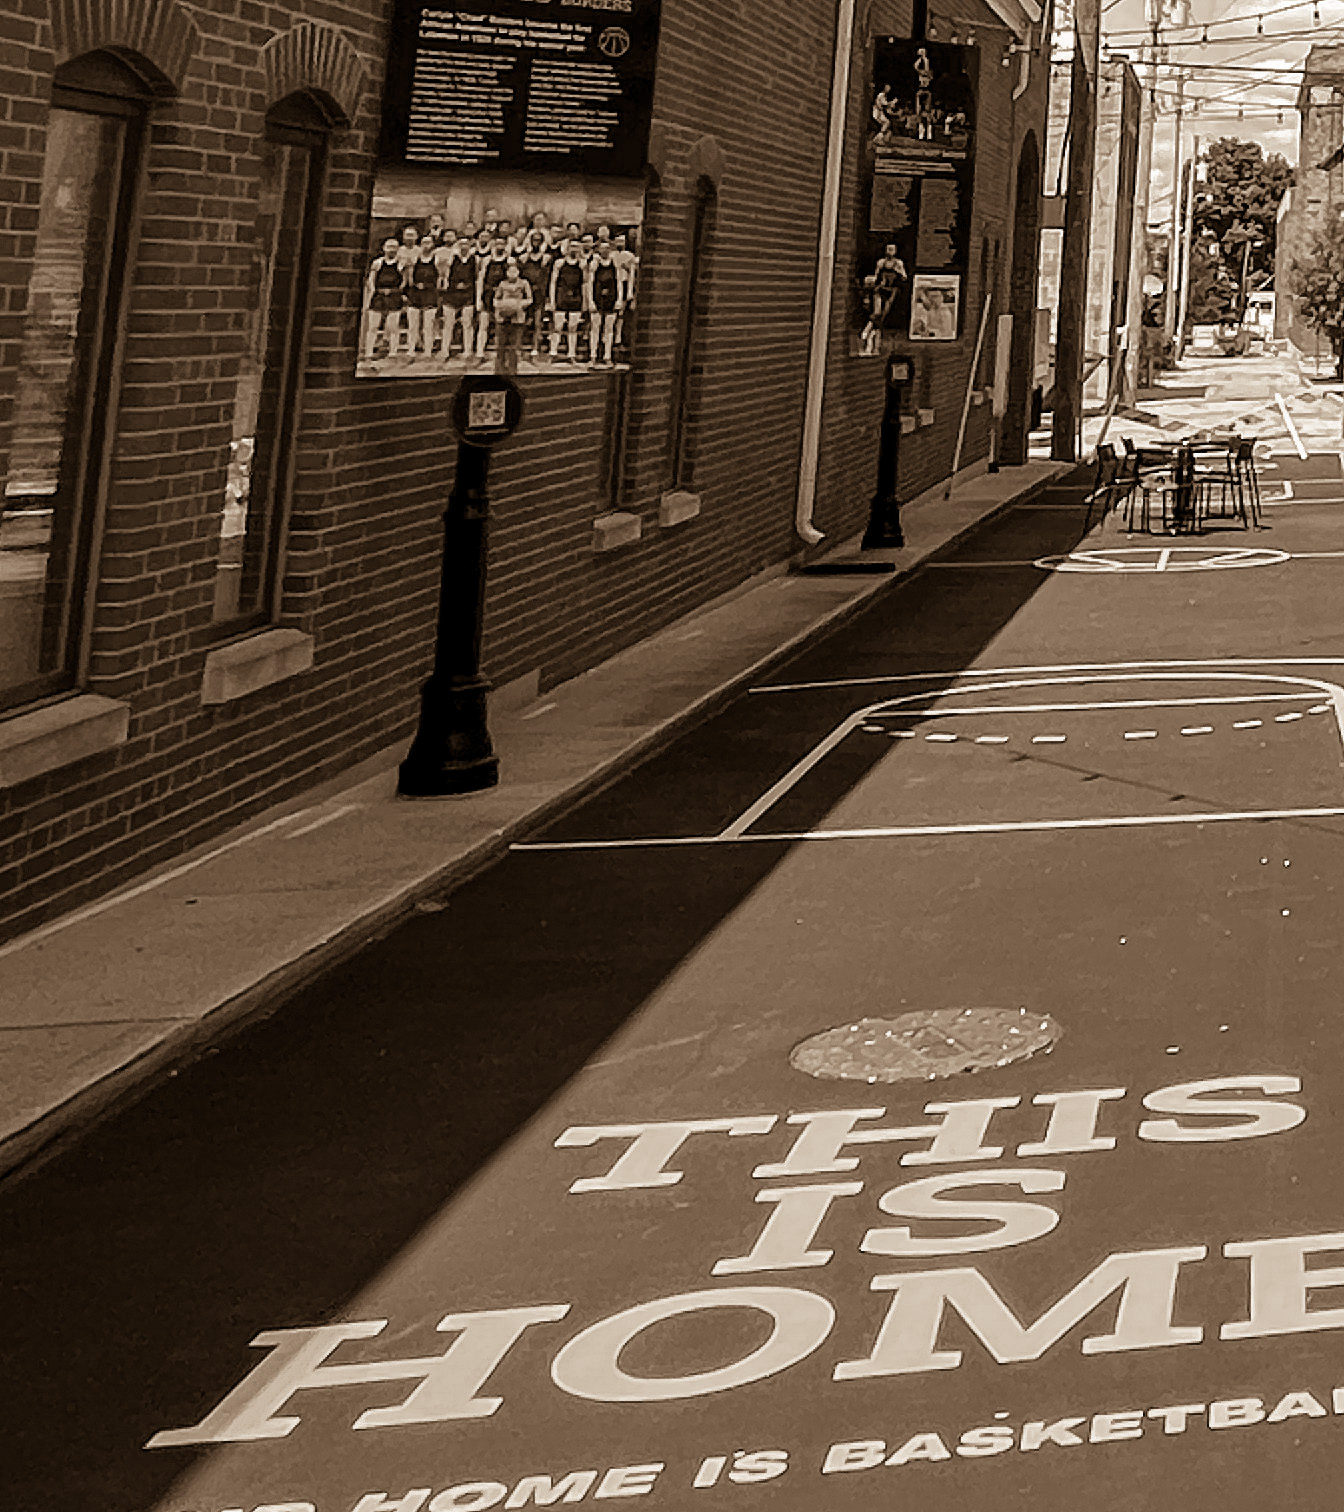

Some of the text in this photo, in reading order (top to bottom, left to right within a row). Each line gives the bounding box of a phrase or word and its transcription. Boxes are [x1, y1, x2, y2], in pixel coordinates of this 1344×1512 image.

[554, 1076, 1307, 1194] THIS
[711, 1169, 1066, 1275] IS
[351, 1462, 664, 1512] HOME
[693, 1449, 788, 1487] IS
